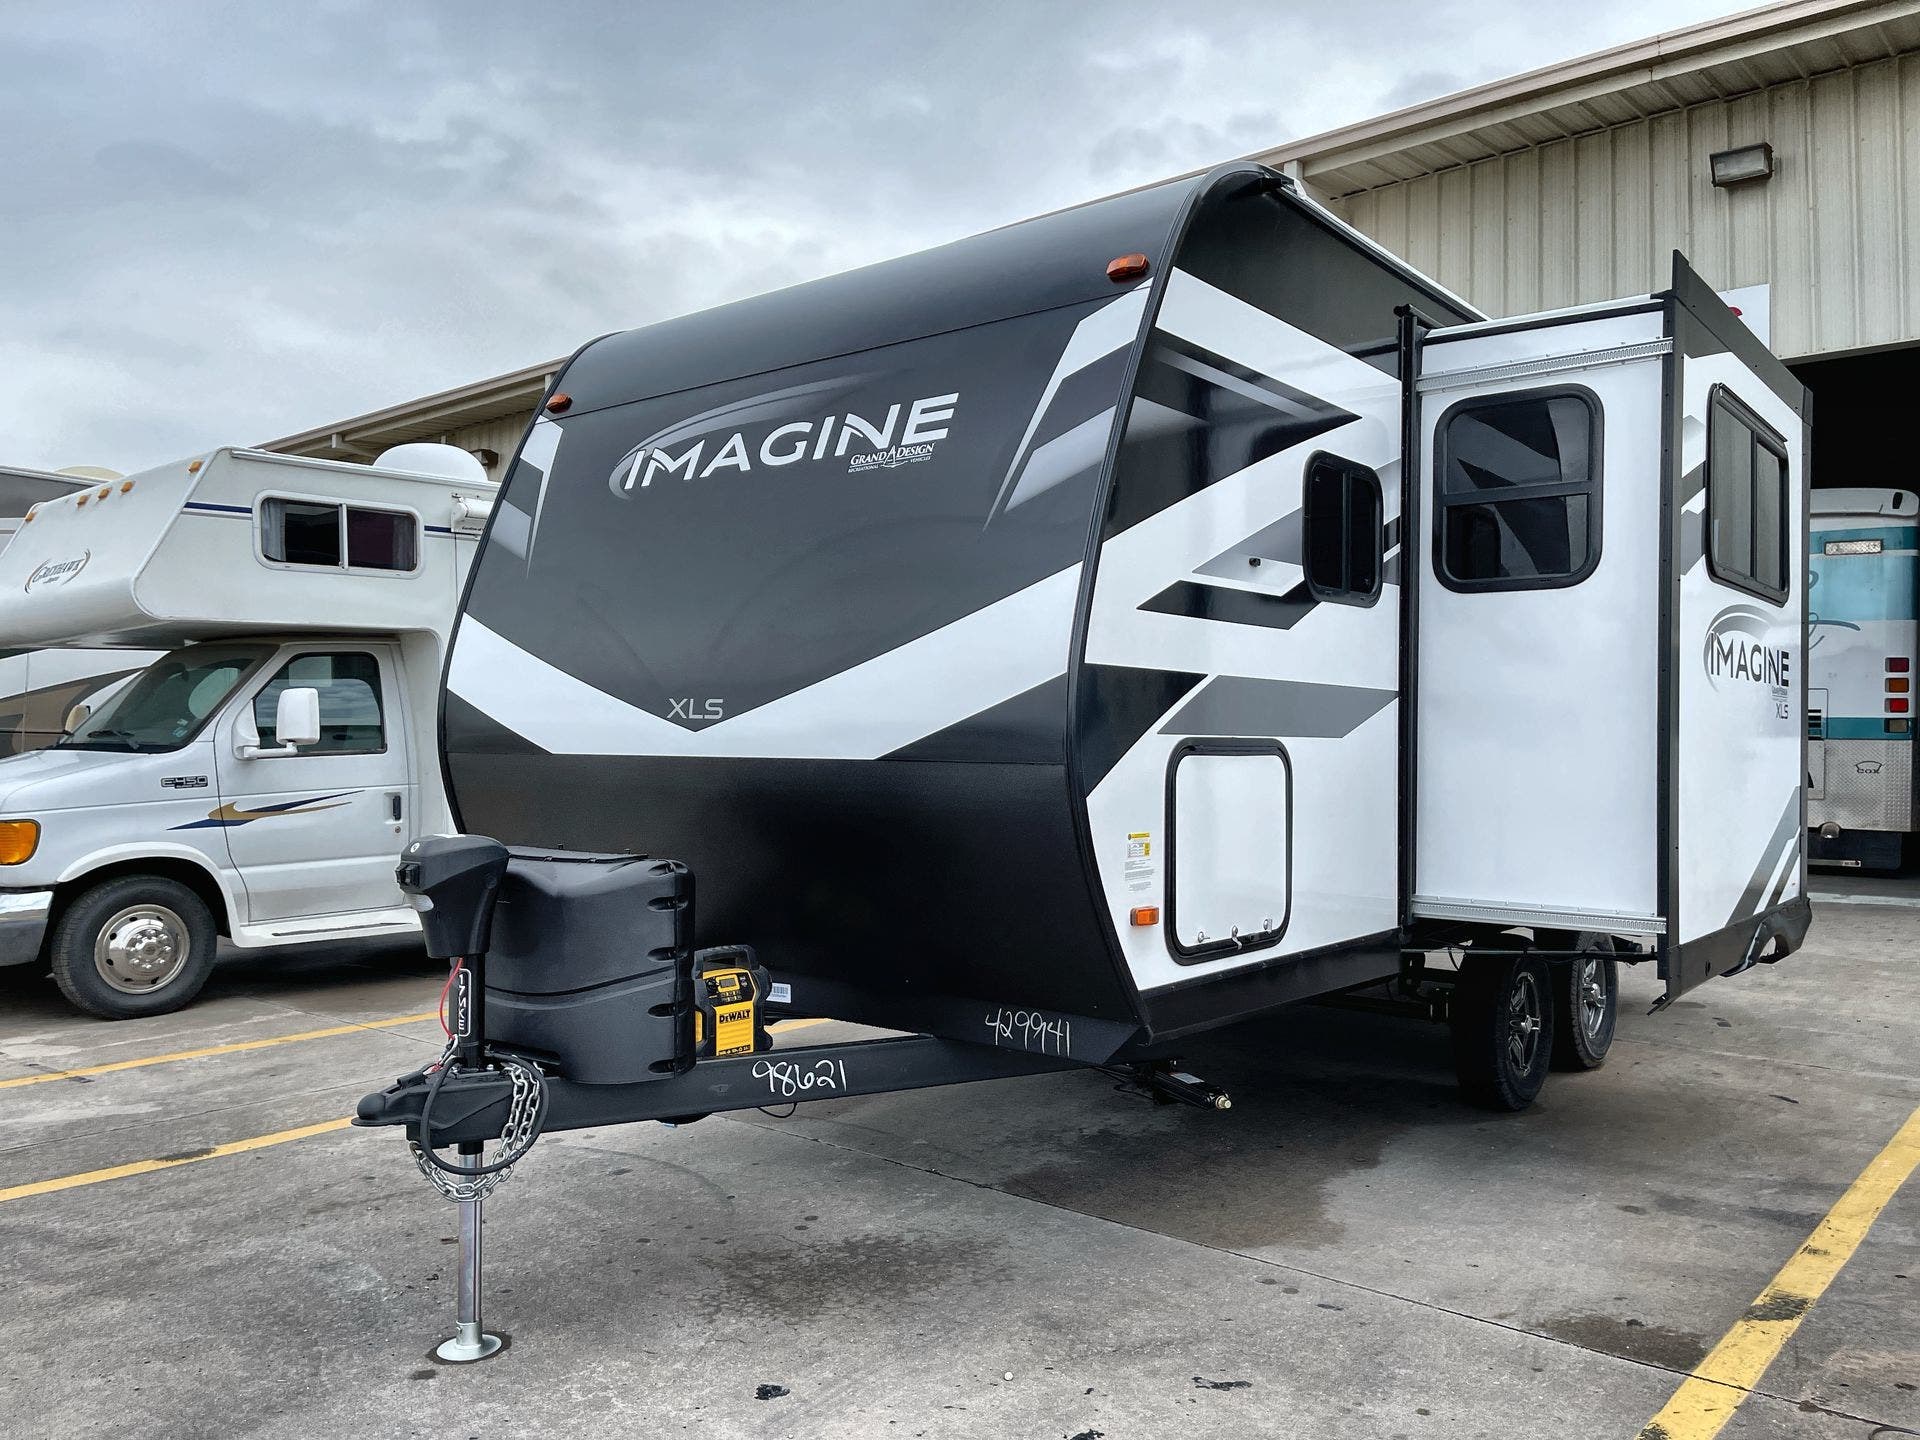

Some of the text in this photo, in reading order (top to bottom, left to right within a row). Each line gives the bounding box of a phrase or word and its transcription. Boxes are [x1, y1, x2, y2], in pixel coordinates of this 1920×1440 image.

[624, 392, 960, 490] IMAGINE
[850, 442, 935, 465] GRAND DESIGN
[1710, 632, 1790, 687] IMAGINE
[667, 698, 724, 720] XLS
[1775, 702, 1789, 720] XLS
[985, 1008, 1070, 1057] 429941
[752, 1060, 847, 1096] 98621
